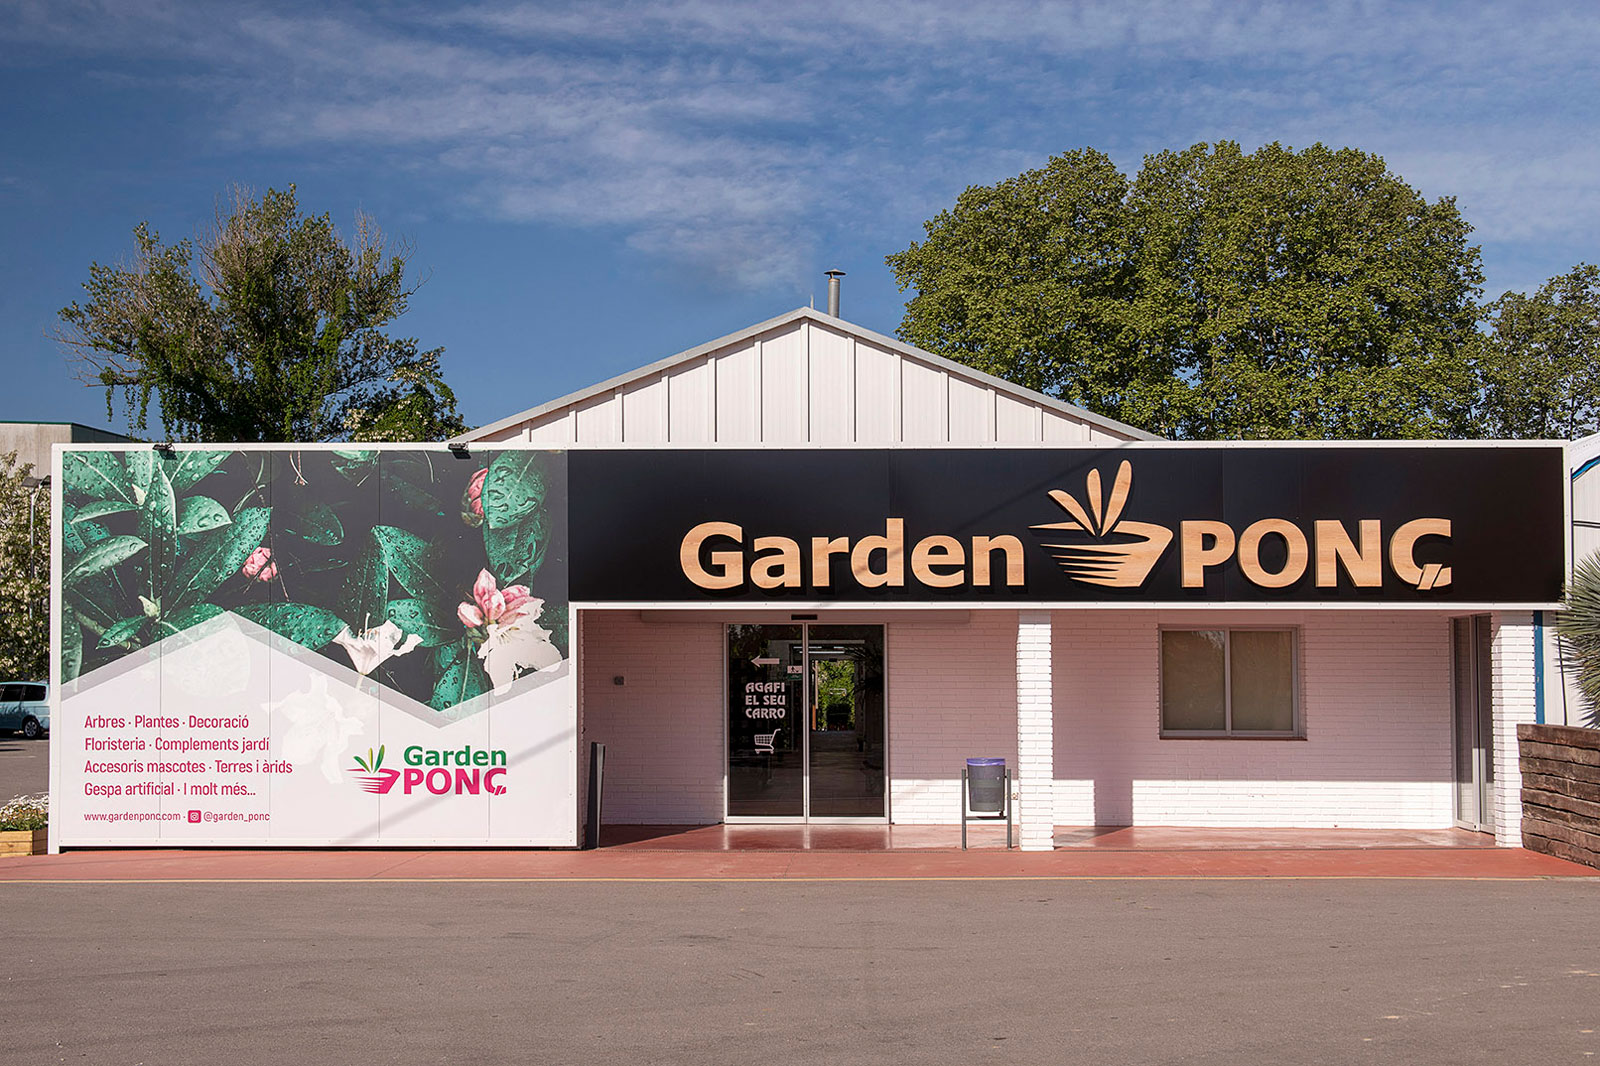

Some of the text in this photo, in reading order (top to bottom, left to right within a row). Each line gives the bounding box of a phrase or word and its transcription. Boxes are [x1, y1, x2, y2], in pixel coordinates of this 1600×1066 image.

[680, 517, 1452, 591] Garden PONÇ
[745, 682, 786, 693] AGAFI
[745, 695, 786, 706] EL SEU
[745, 708, 786, 719] CARRO
[84, 714, 250, 728] Arbres Plantes Decoració
[84, 736, 270, 754] Floristeria Complements jardí
[403, 745, 507, 767] Garden
[84, 759, 293, 773] Accesoris mascotes Terres i àrids
[403, 767, 507, 796] PONÇ
[84, 781, 123, 798] Gespa
[124, 781, 175, 795] artificial
[183, 782, 187, 795] I
[190, 782, 219, 795] molt
[83, 811, 271, 823] www.gardenponc.com @garden_ponc
